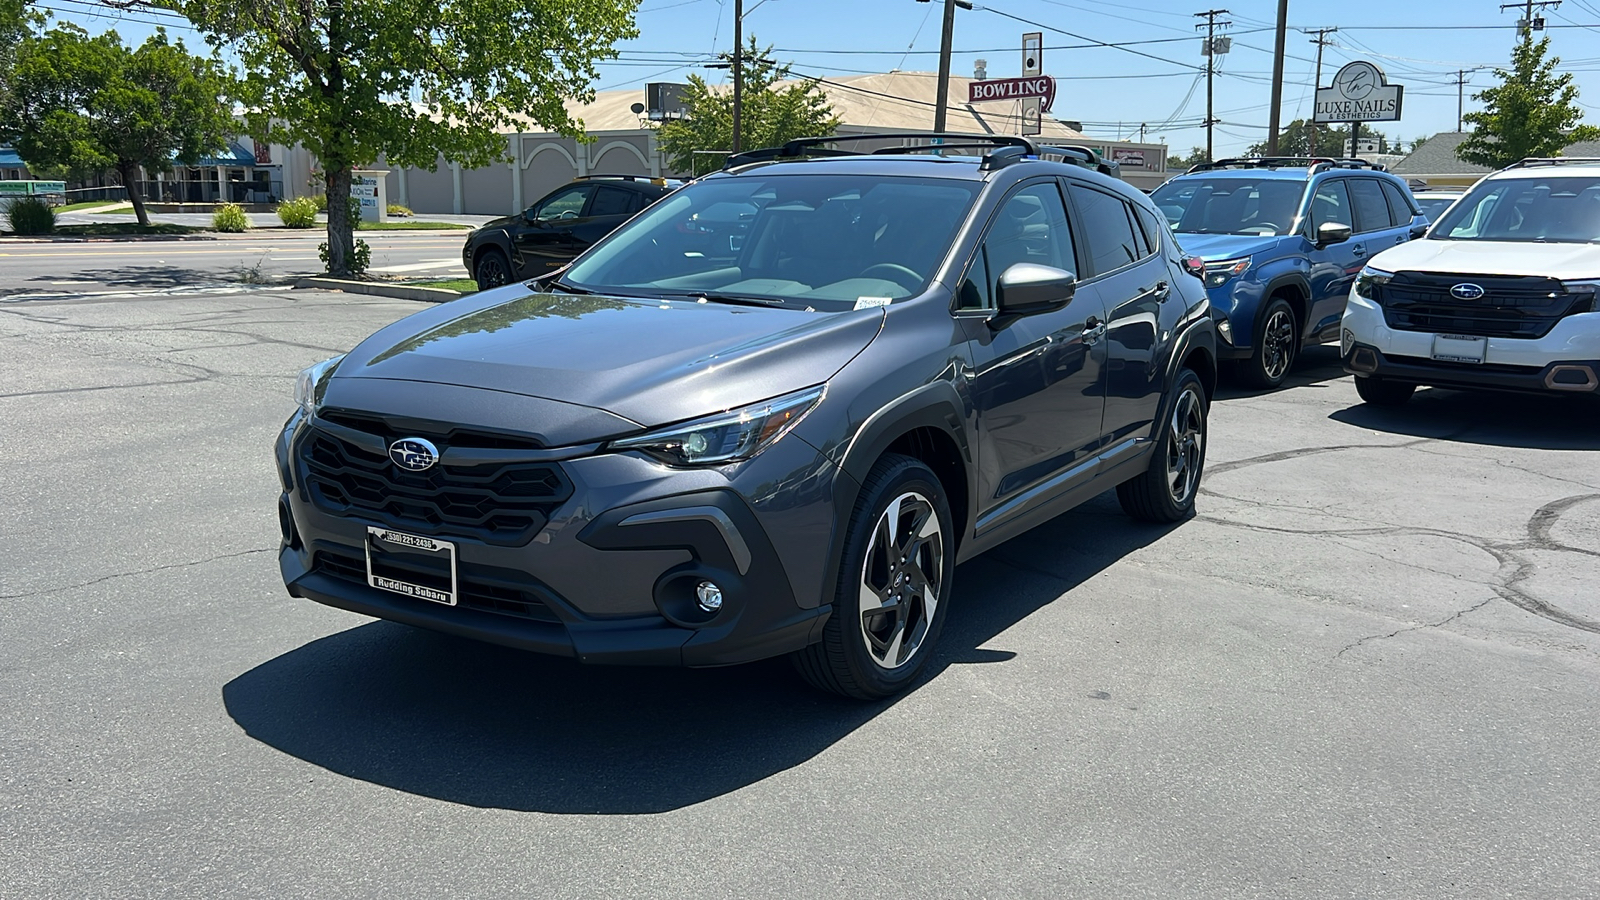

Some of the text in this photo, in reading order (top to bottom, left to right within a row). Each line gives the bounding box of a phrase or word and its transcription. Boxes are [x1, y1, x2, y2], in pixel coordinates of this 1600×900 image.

[973, 79, 1048, 99] BOWLING
[1317, 99, 1396, 114] LUXE NAILS
[1336, 112, 1381, 120] ESTHETICS
[402, 535, 432, 549] 221-2436
[414, 586, 447, 601] Subaru
